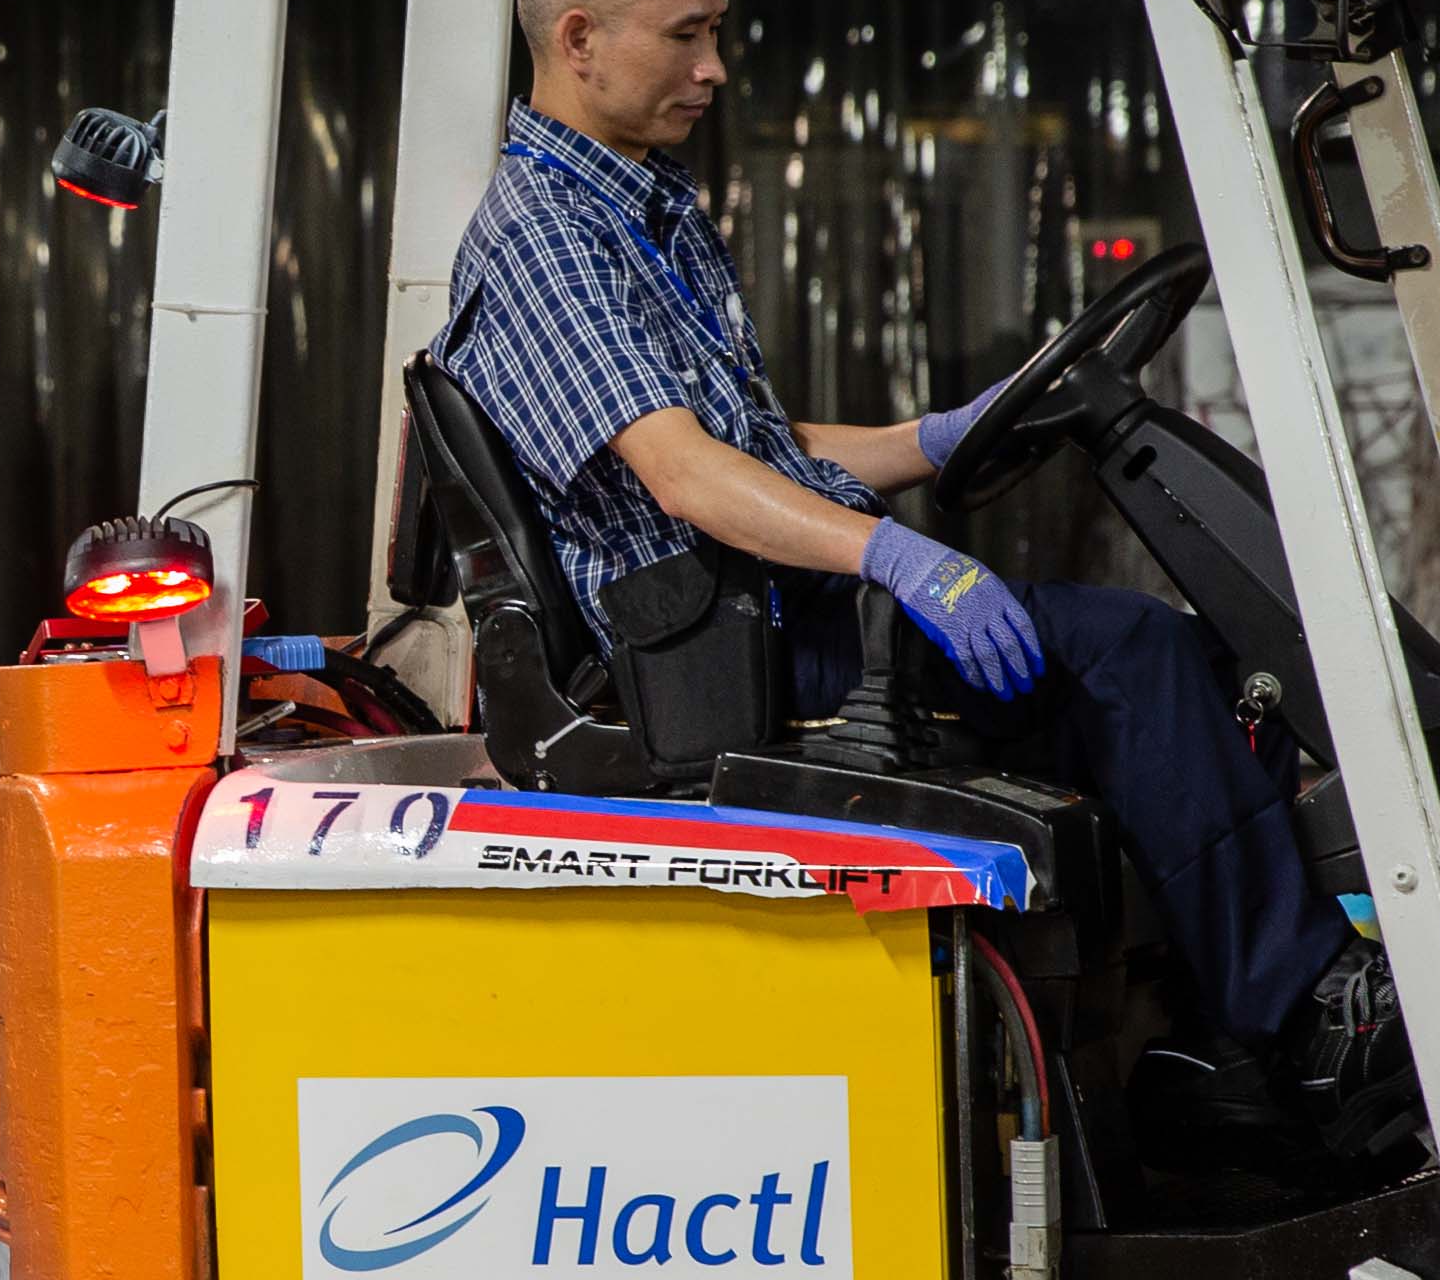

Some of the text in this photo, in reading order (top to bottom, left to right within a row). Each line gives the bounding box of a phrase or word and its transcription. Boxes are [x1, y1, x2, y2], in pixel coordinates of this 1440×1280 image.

[239, 786, 450, 860] 170
[477, 844, 903, 895] SMART FORKLIFT
[531, 1160, 830, 1267] Hactl
